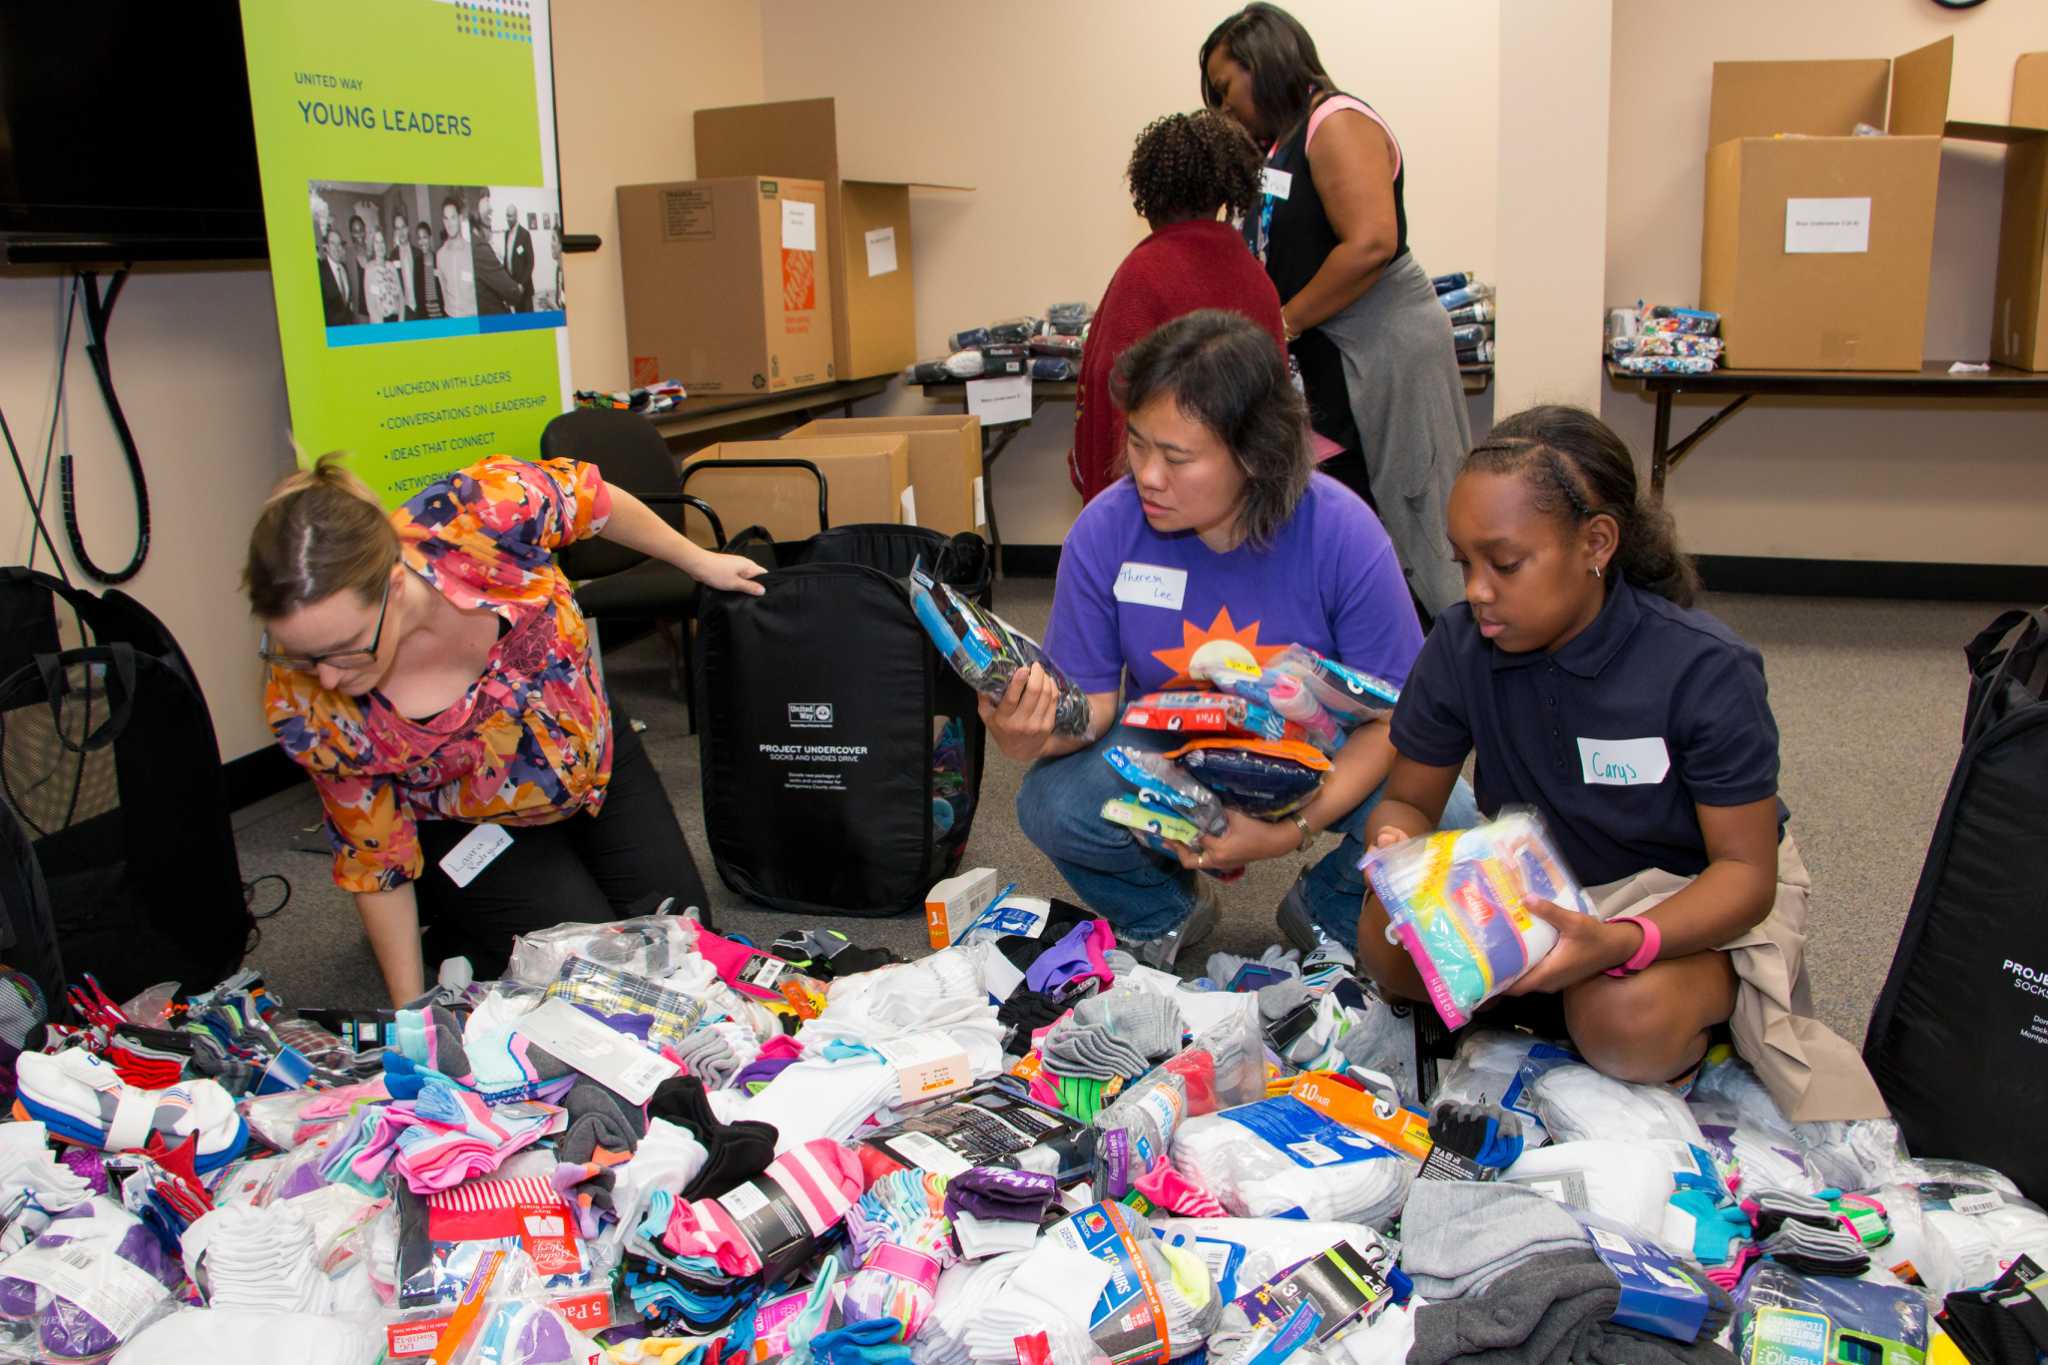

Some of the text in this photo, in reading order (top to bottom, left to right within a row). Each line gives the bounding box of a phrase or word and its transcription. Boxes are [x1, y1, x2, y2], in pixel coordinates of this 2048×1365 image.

[294, 71, 364, 91] UNITED WAY
[298, 100, 473, 137] YOUNG LEADERS
[383, 371, 513, 399] LUNCHEON WITH LEADERS
[386, 395, 548, 430] CONVERSATIONS ON LEADERSHIP
[391, 431, 496, 461] IDEAS THAT CONNECT
[759, 744, 868, 755] PROJECT UNDERCOVER
[770, 753, 794, 761] SOCKS
[811, 754, 837, 762] UNDIES
[838, 755, 859, 763] DRIVE
[1592, 751, 1637, 785] Carys
[1298, 1082, 1319, 1102] 10
[1111, 1264, 1132, 1295] PAIRS
[1362, 1274, 1384, 1293] 4-6
[1282, 1283, 1299, 1297] 3
[560, 1300, 602, 1319] 5 Pac
